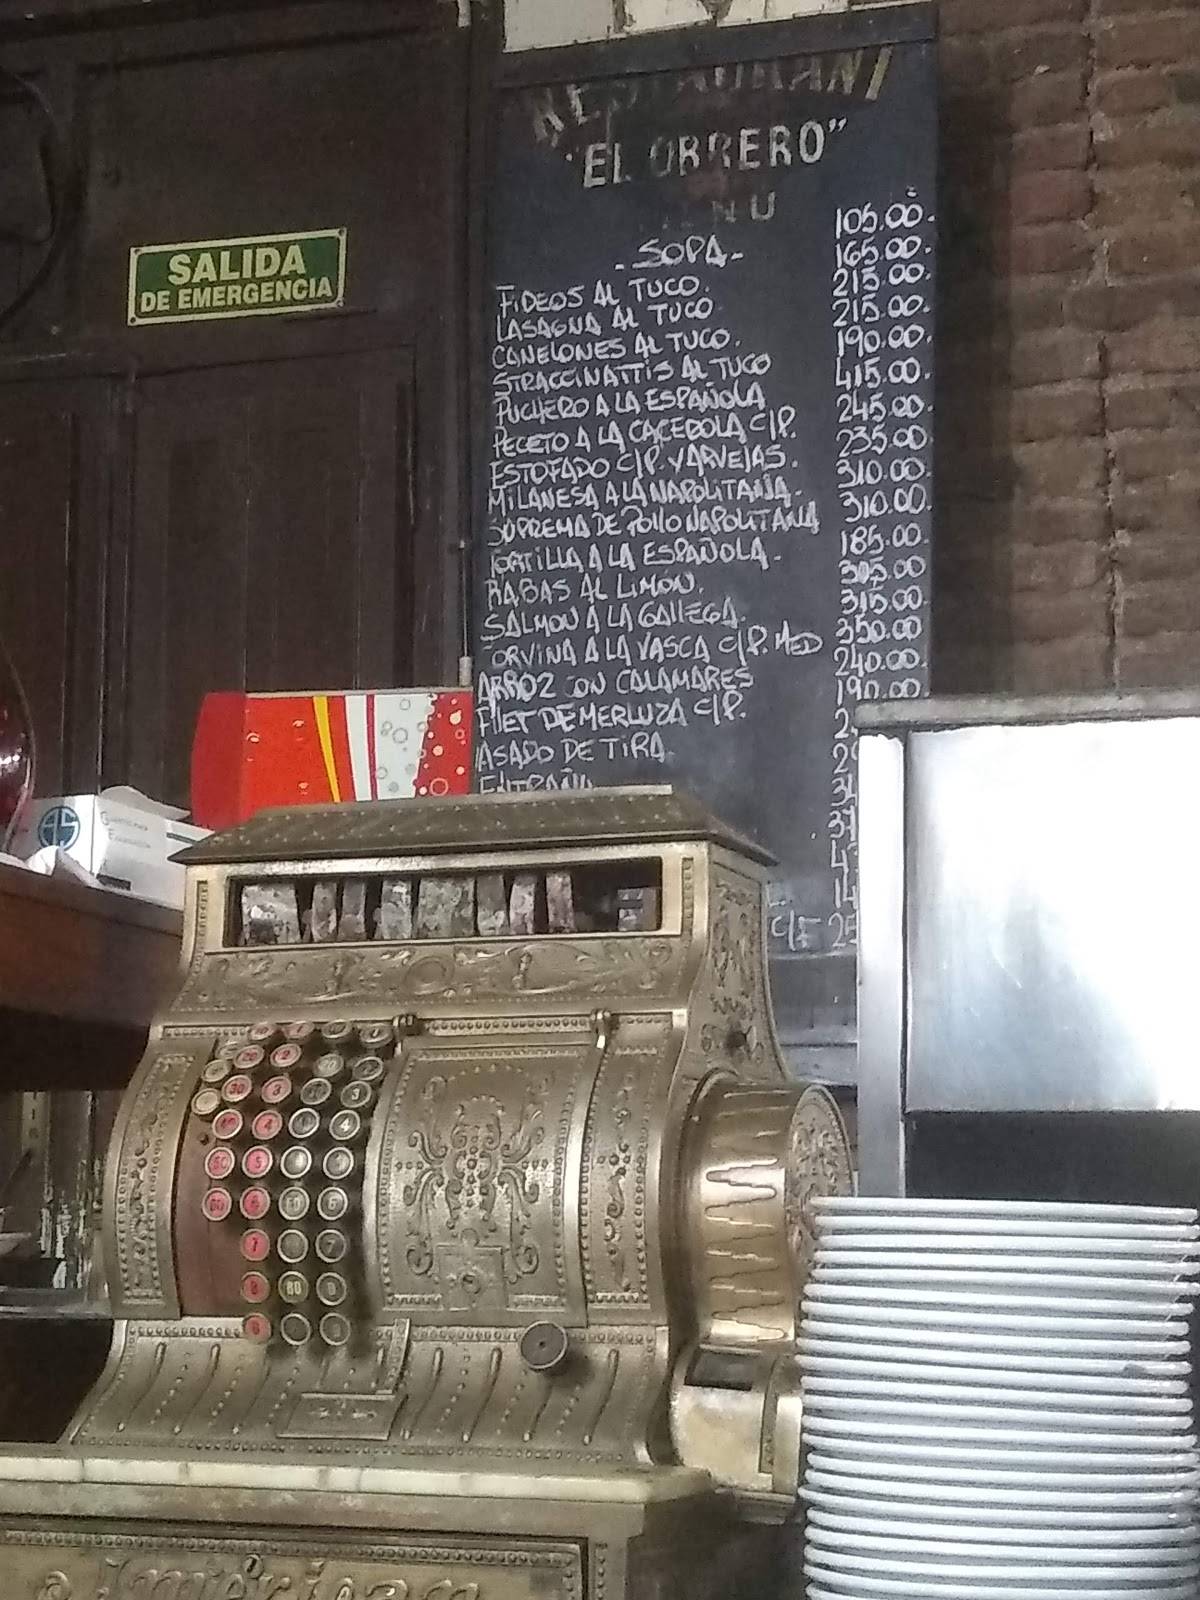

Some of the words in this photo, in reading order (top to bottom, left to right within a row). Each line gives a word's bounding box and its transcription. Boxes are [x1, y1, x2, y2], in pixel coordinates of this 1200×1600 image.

[168, 244, 306, 286] SALIDA
[140, 290, 170, 313] DE
[177, 276, 333, 310] EMERGENCIA
[593, 279, 620, 308] AL
[496, 311, 602, 344] LASAGNA
[612, 304, 640, 331] AL
[491, 336, 627, 369] CANELONES
[634, 331, 664, 359] AL
[680, 354, 709, 383] AL
[708, 352, 773, 381] TUCO
[595, 392, 611, 418] A
[614, 389, 642, 415] LA
[645, 379, 767, 413] ESPAÑOLA
[493, 425, 570, 458] PECETO
[574, 426, 592, 453] A
[598, 420, 628, 454] LA
[488, 456, 611, 491] ESTOFADO
[606, 480, 620, 506] A
[621, 476, 649, 506] LA
[592, 511, 623, 537] DE
[588, 543, 604, 573] A
[608, 542, 636, 573] LA
[484, 577, 572, 612] RABAS
[580, 572, 609, 604] AL
[480, 605, 580, 642] SALMON
[585, 604, 601, 635] A
[606, 602, 634, 633] LA
[584, 635, 600, 664] A
[606, 634, 633, 664] LA
[635, 631, 711, 664] VASCA
[615, 664, 755, 697] CALAMARES
[538, 701, 577, 733] DE
[474, 739, 555, 772] ASADO
[560, 737, 595, 764] DE
